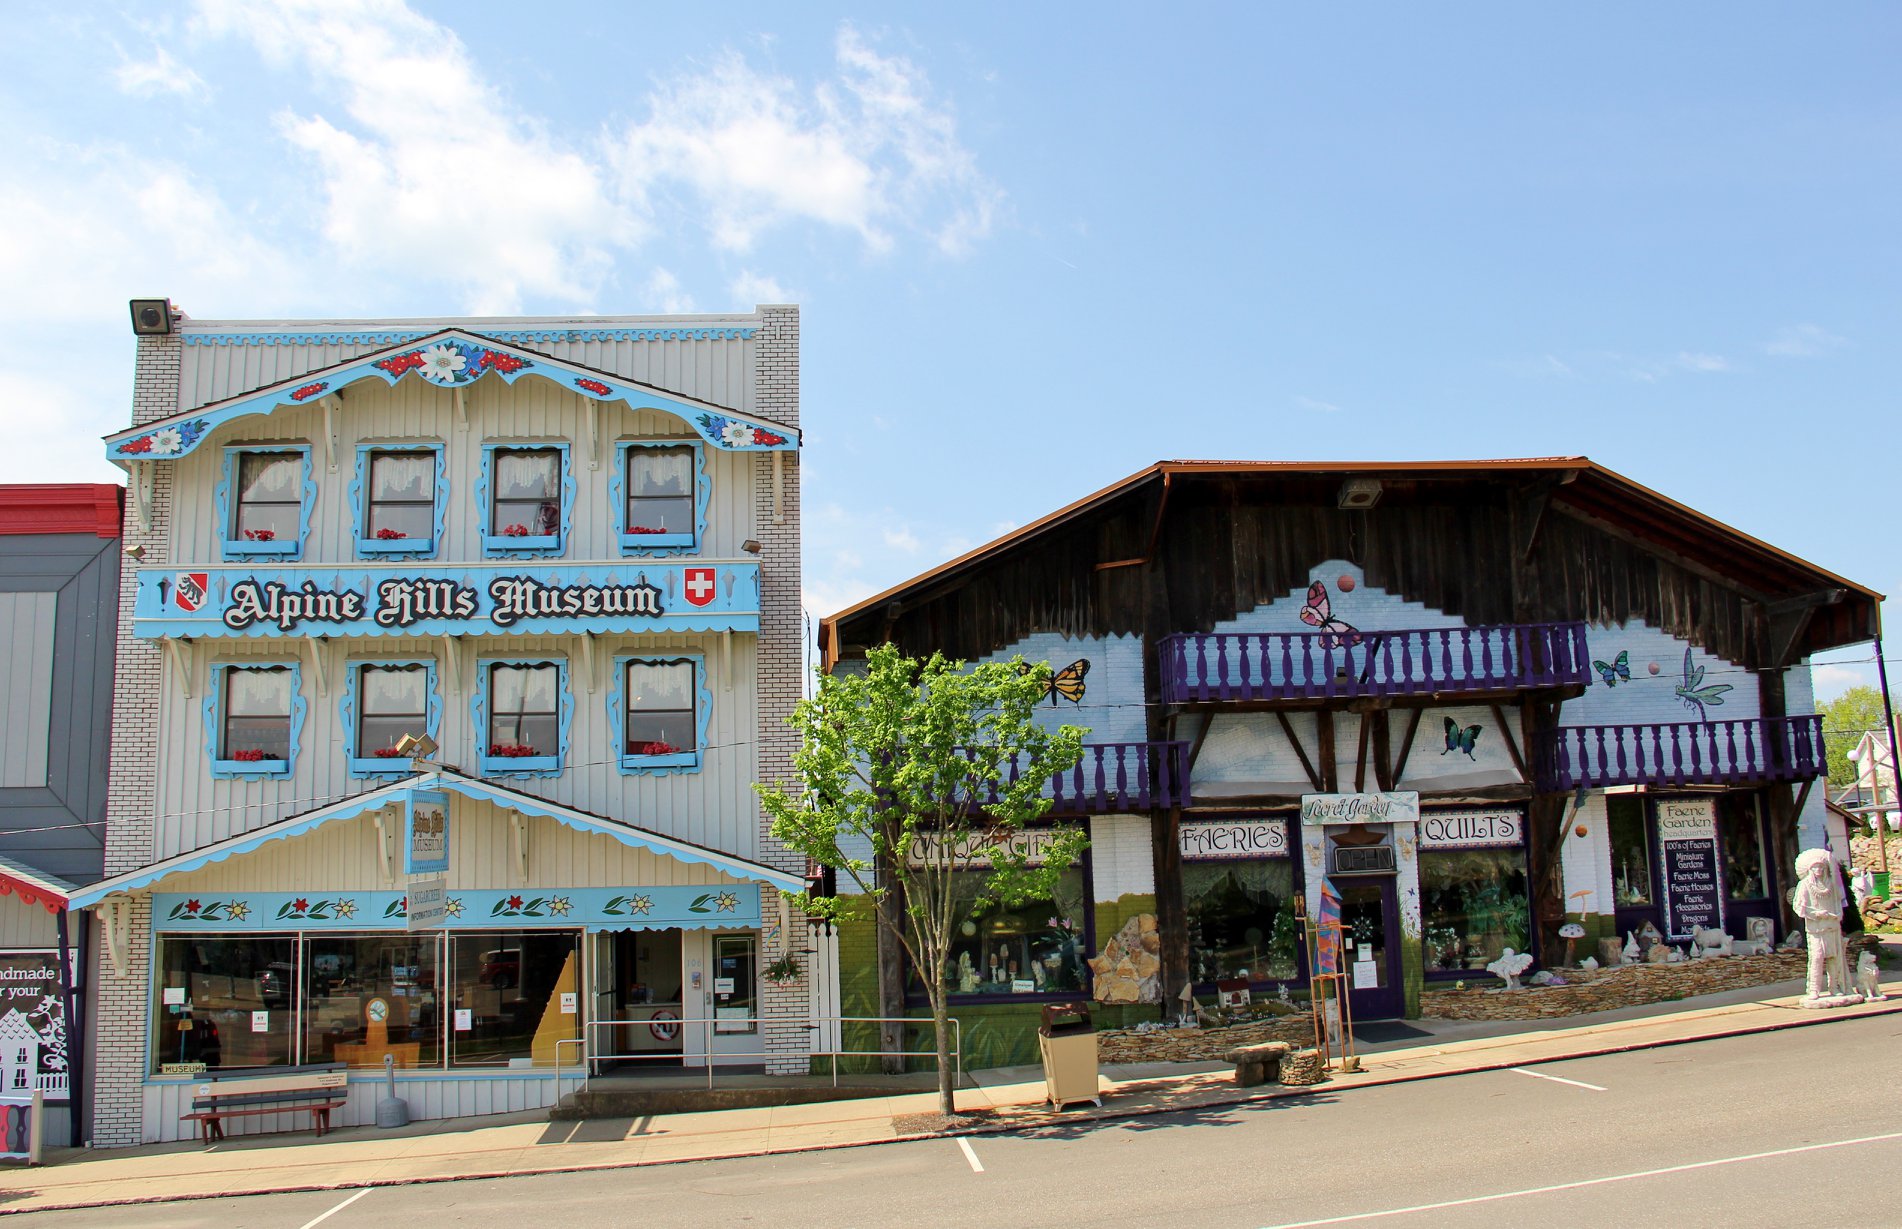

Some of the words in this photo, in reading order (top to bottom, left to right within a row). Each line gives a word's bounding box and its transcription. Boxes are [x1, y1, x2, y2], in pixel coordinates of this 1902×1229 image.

[224, 581, 363, 630] Alpine
[377, 580, 477, 626] Hills
[490, 579, 661, 625] Museum
[1667, 805, 1706, 817] Faerie
[1425, 815, 1515, 840] QUILTS
[1662, 817, 1711, 828] Garden
[1181, 825, 1284, 853] FAERIES
[412, 838, 443, 852] MUSEUM
[1689, 840, 1712, 849] Faeries
[1675, 852, 1704, 861] Miniature
[1677, 860, 1704, 869] Gardens
[1673, 871, 1693, 880] Faerie
[1693, 871, 1710, 879] Moss
[1671, 883, 1690, 892] Faerie
[1690, 882, 1714, 891] Houses
[1684, 894, 1704, 903] Faerie
[1675, 902, 1713, 912] Accessories
[1681, 914, 1709, 923] Dragons
[8, 987, 41, 1000] your
[165, 1065, 201, 1073] MUSEUM
